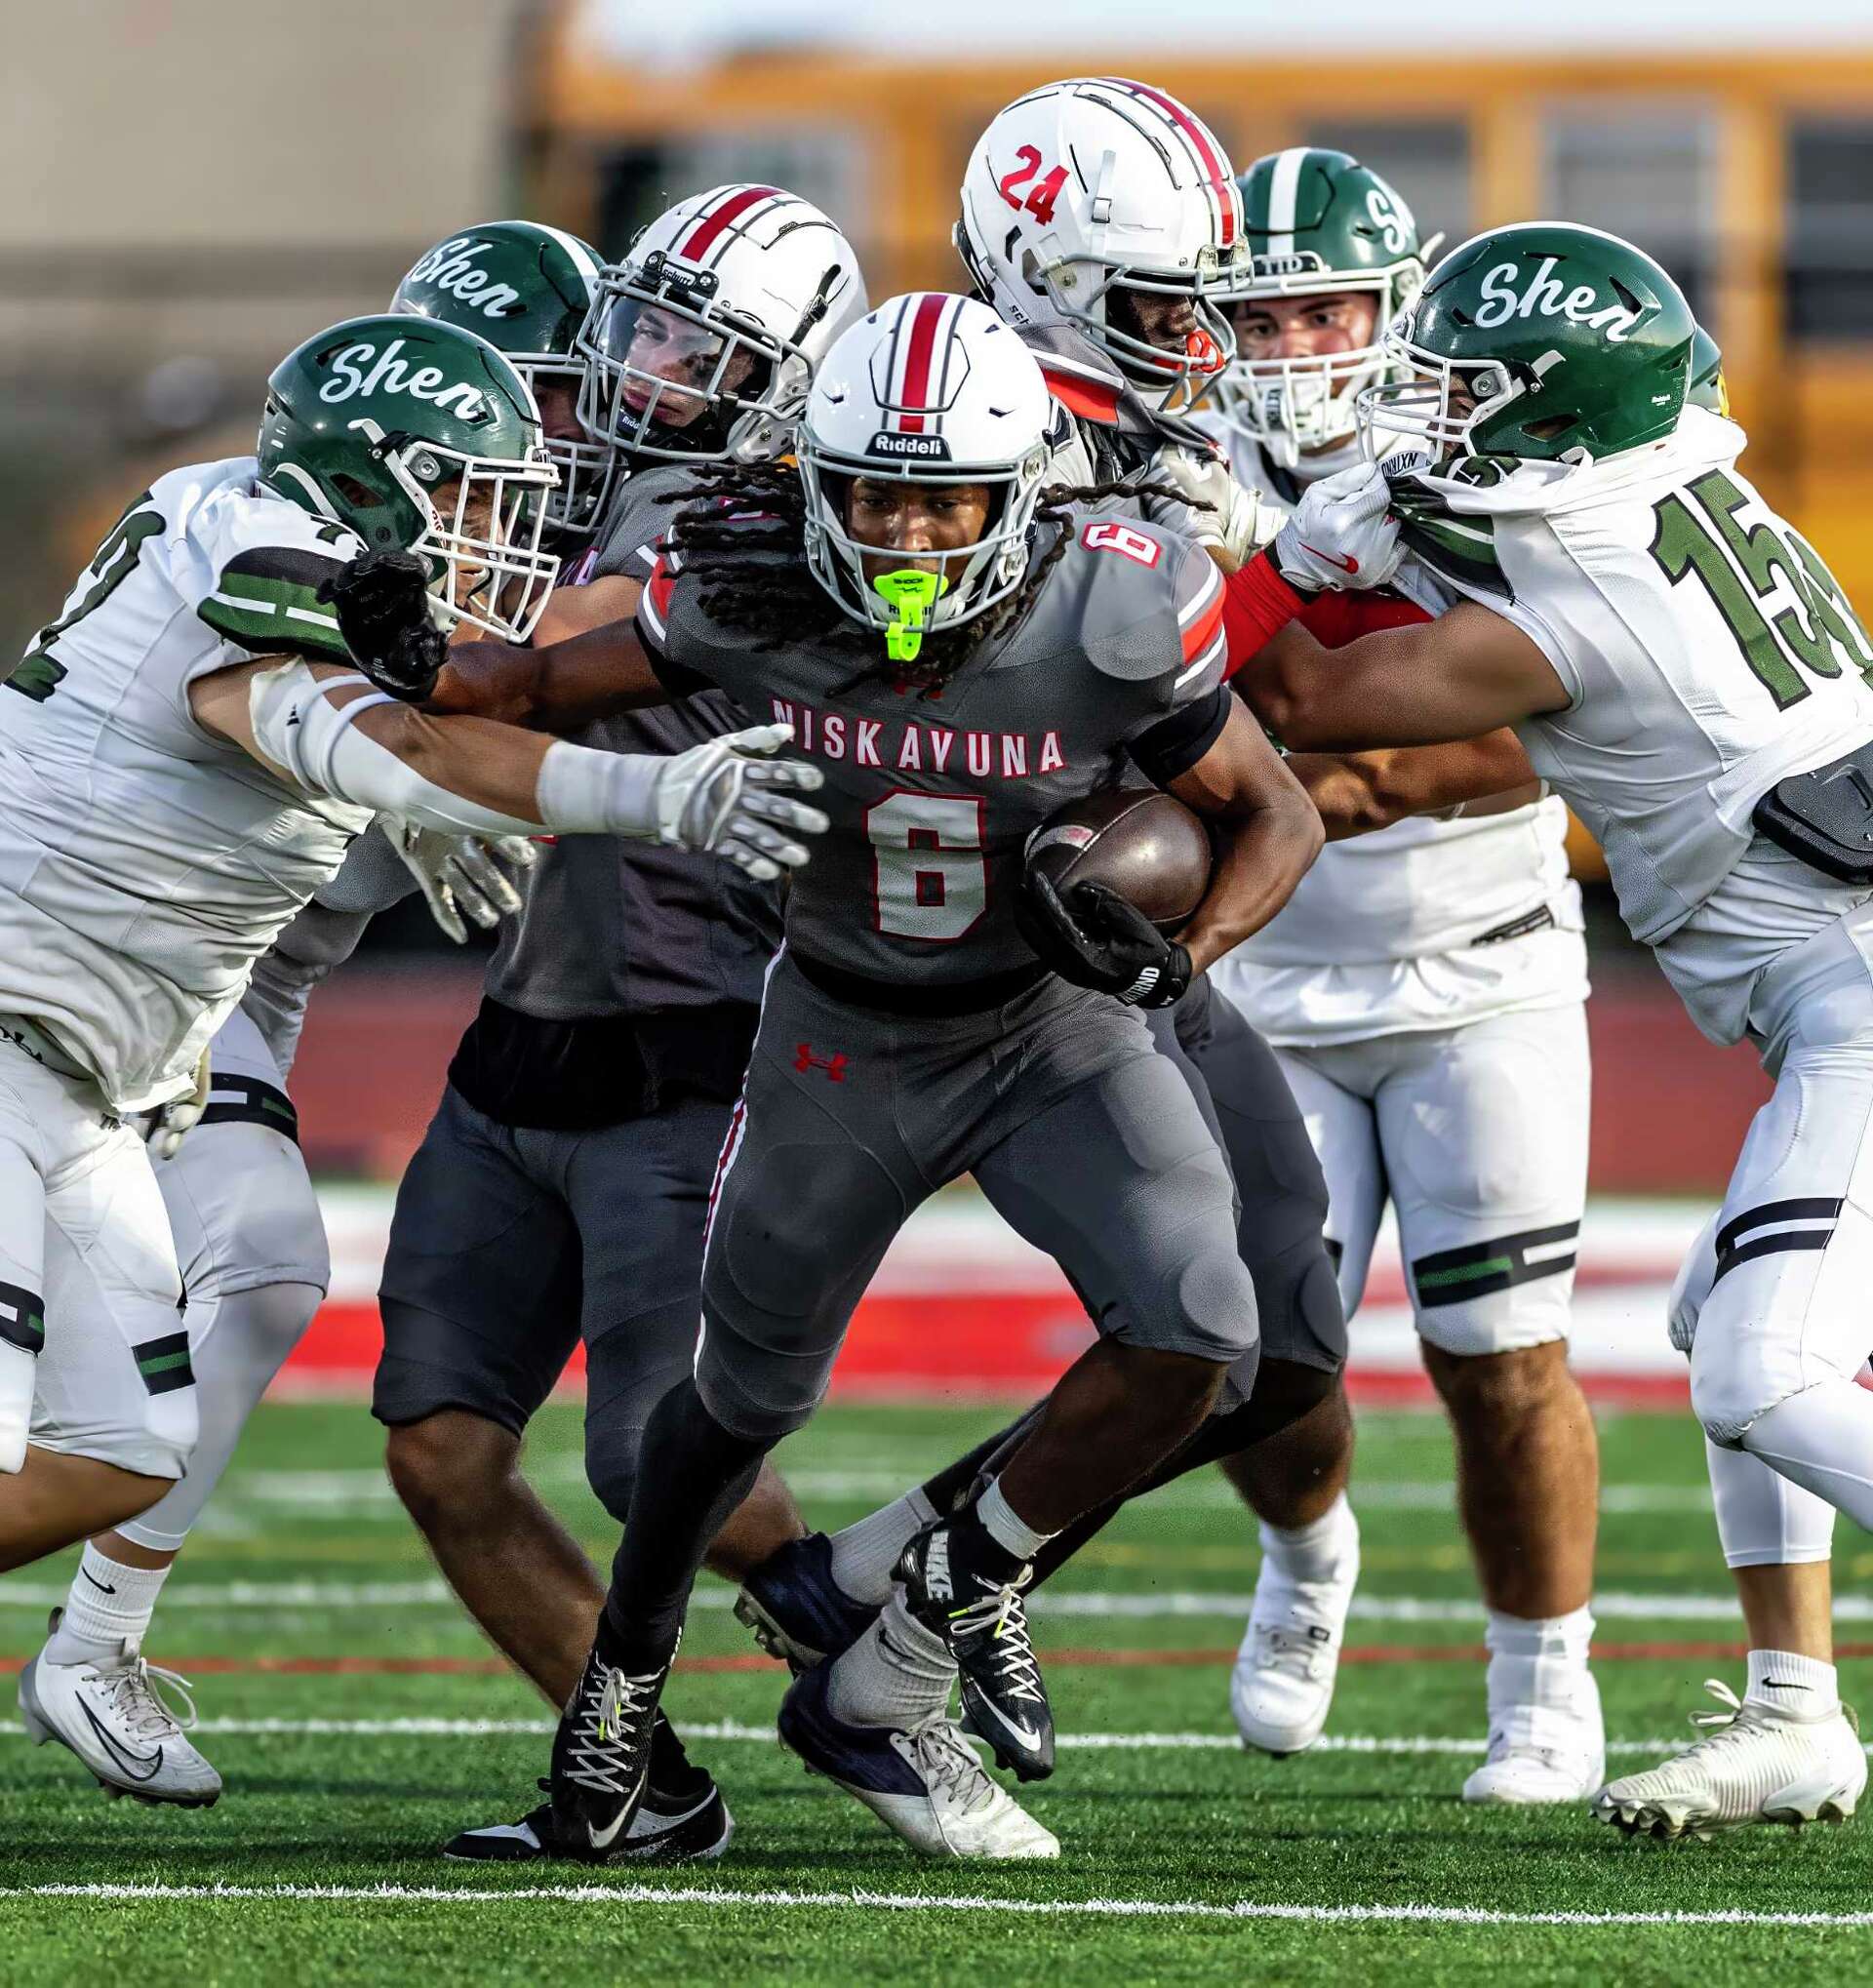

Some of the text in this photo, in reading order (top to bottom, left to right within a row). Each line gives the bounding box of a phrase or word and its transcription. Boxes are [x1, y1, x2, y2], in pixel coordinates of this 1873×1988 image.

[999, 143, 1070, 226] 24
[415, 237, 521, 318] Shen
[1475, 256, 1649, 342] Shen
[319, 339, 489, 421] Shen
[875, 435, 941, 456] Riddell
[1081, 523, 1162, 569] 6
[772, 699, 1067, 776] NISKAYUNA
[863, 789, 988, 944] 6
[926, 1531, 955, 1602] NIKE
